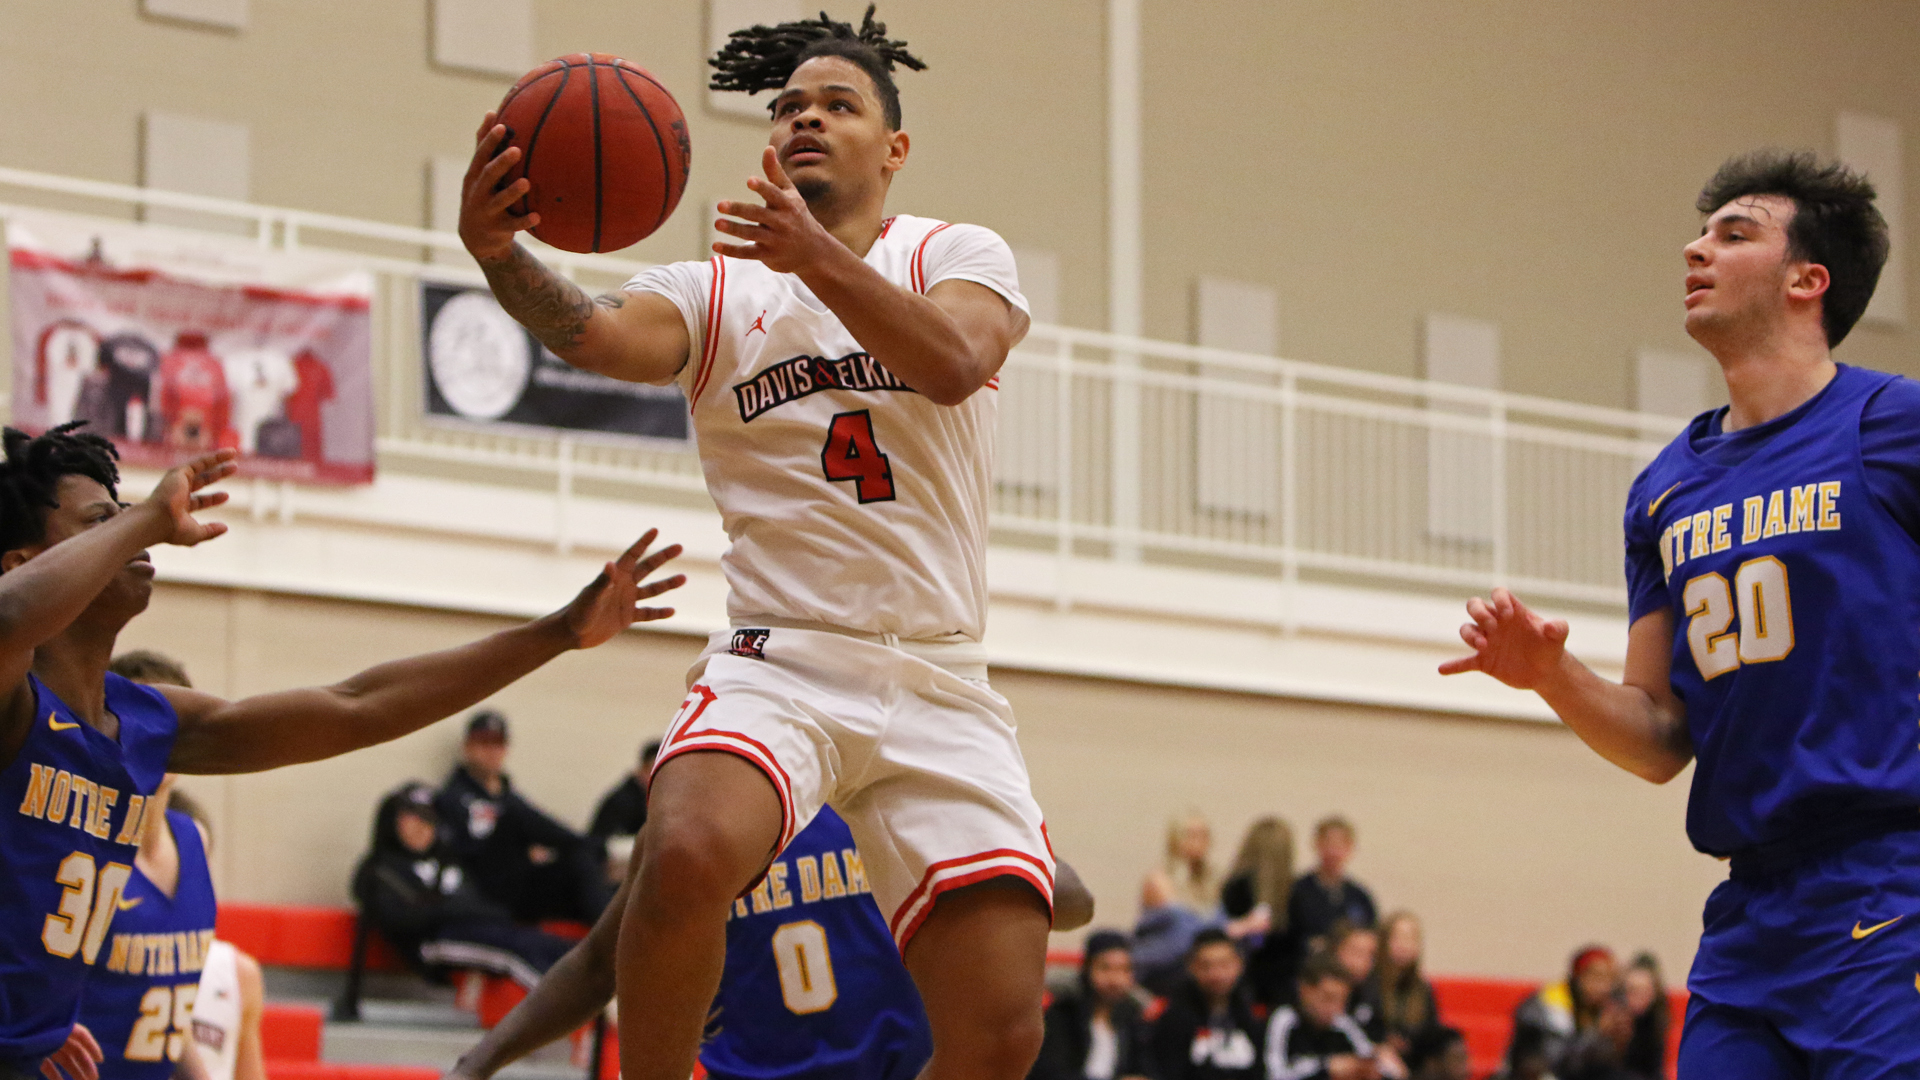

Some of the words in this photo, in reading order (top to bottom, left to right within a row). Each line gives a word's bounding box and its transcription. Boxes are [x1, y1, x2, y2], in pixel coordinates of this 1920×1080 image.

[821, 409, 896, 504] 4
[1659, 503, 1733, 586] OTRE
[1741, 480, 1841, 546] DAME
[1682, 555, 1795, 682] 20
[18, 762, 119, 841] NOTRE
[42, 851, 132, 966] 30
[796, 848, 871, 904] DAM
[772, 919, 838, 1015] 0
[124, 983, 199, 1062] 25
